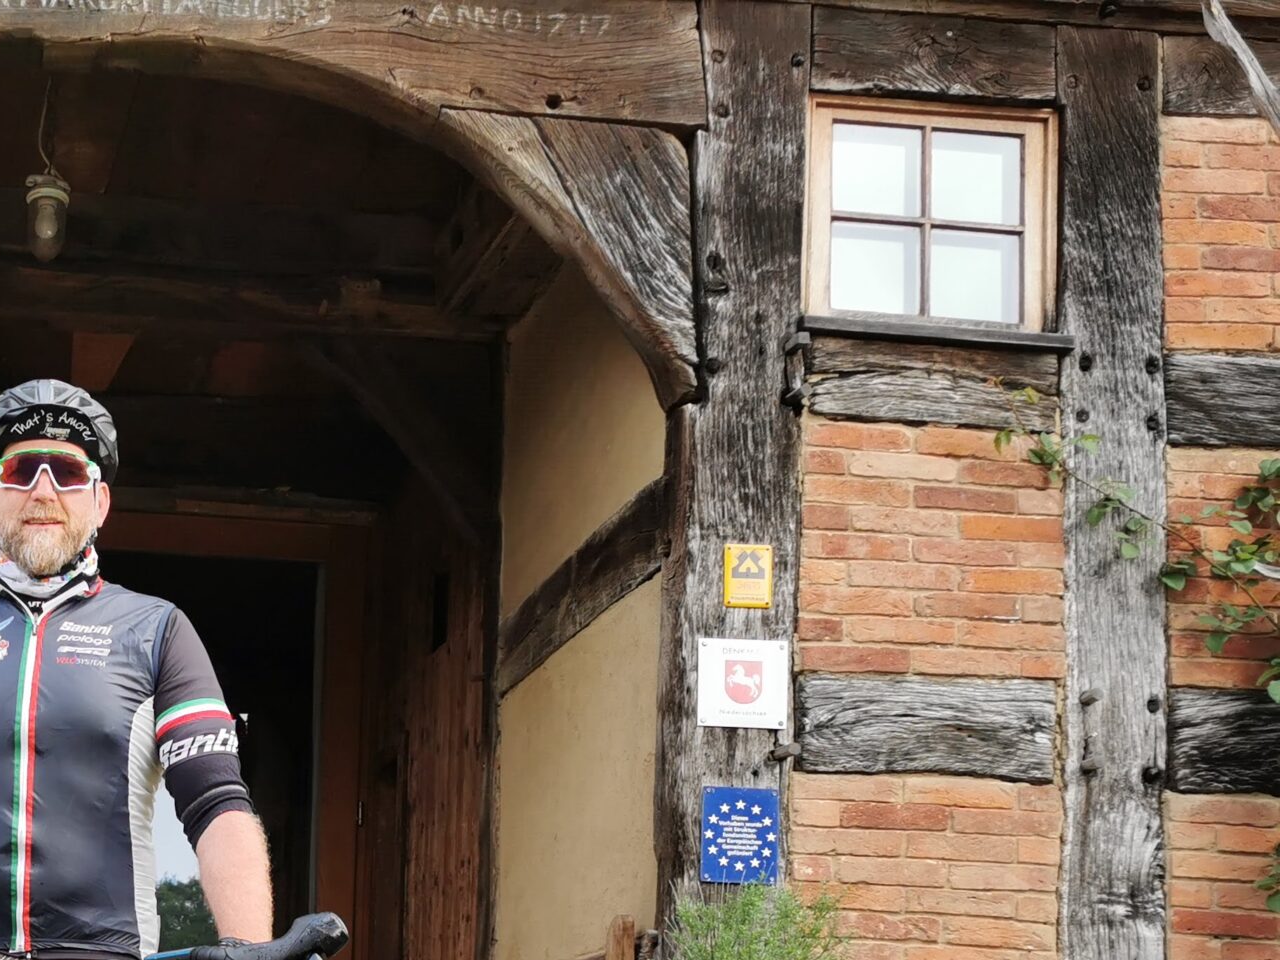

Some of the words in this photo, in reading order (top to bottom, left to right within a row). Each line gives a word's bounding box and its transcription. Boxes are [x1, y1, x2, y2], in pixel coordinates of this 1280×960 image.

[426, 4, 521, 32] ANNO
[10, 409, 54, 435] That's
[59, 621, 113, 636] Santini
[56, 634, 113, 646] prologo
[722, 647, 760, 655] DENK
